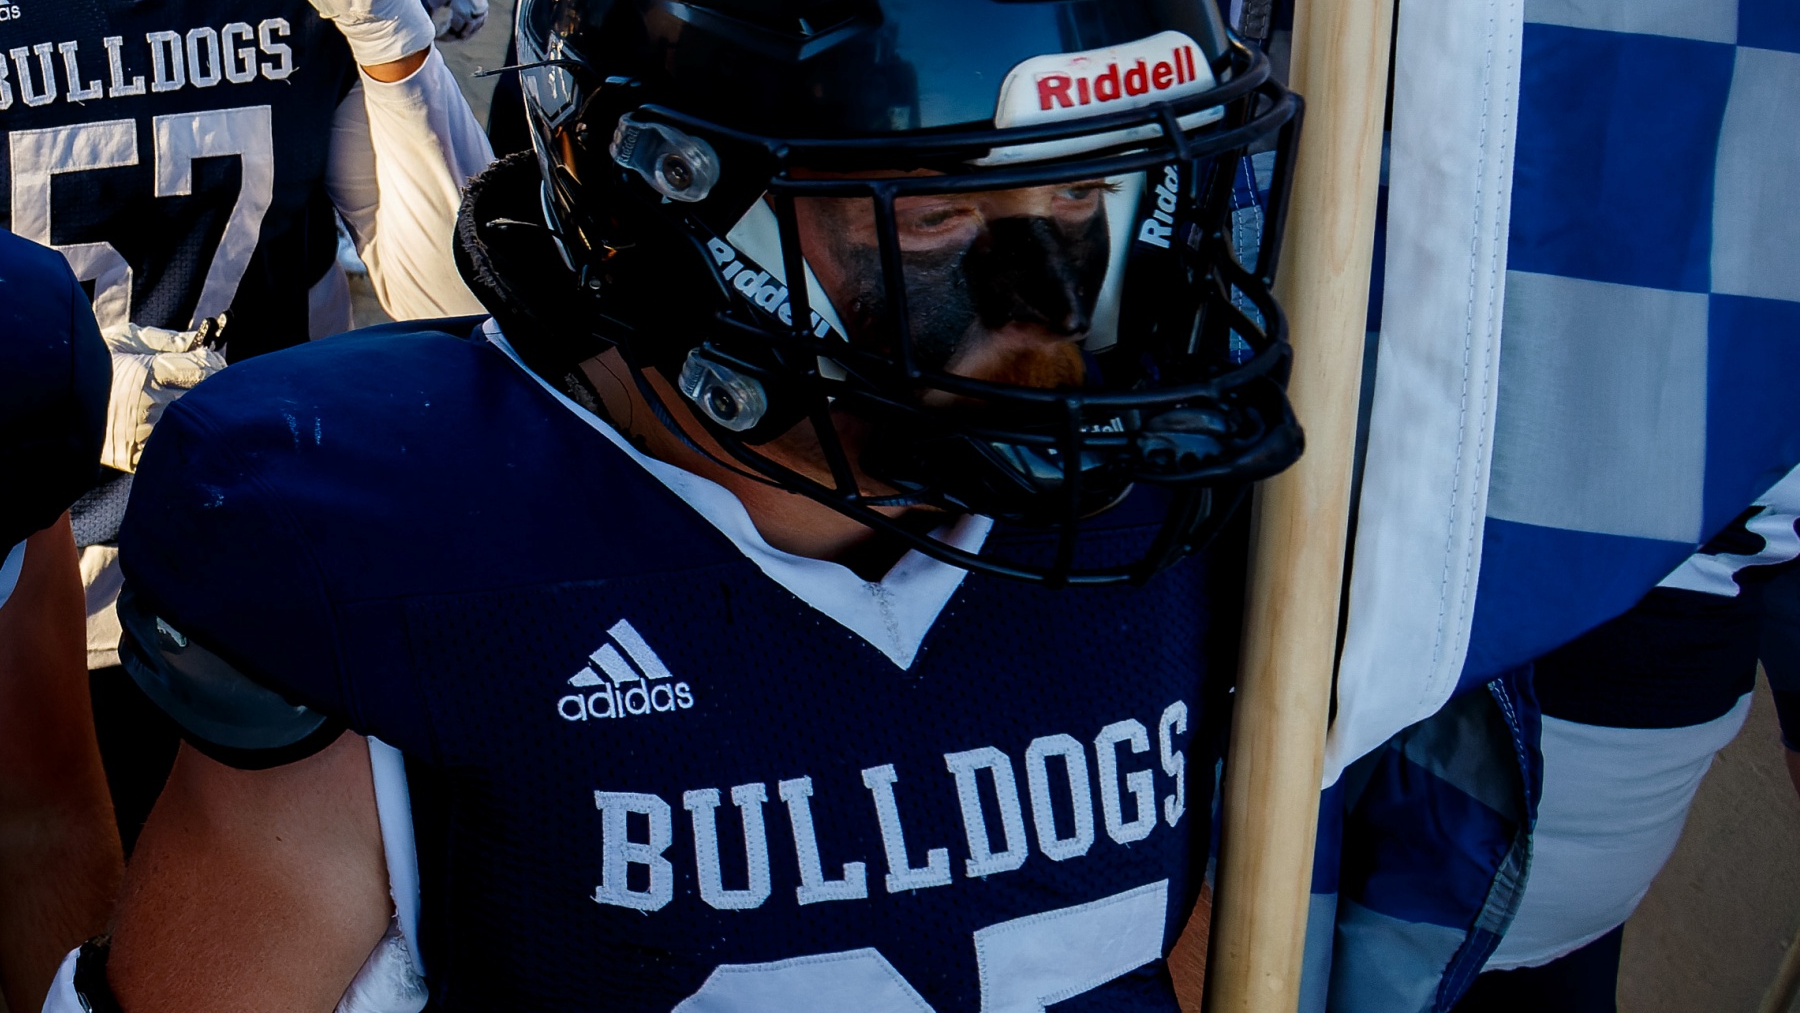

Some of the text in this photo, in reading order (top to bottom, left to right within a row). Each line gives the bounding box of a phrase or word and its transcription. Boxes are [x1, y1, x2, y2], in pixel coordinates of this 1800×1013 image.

[1036, 45, 1196, 111] Riddell
[9, 105, 274, 331] 57
[1139, 164, 1179, 249] Ridd
[557, 679, 694, 722] adidas
[592, 699, 1189, 913] BULLDOGS
